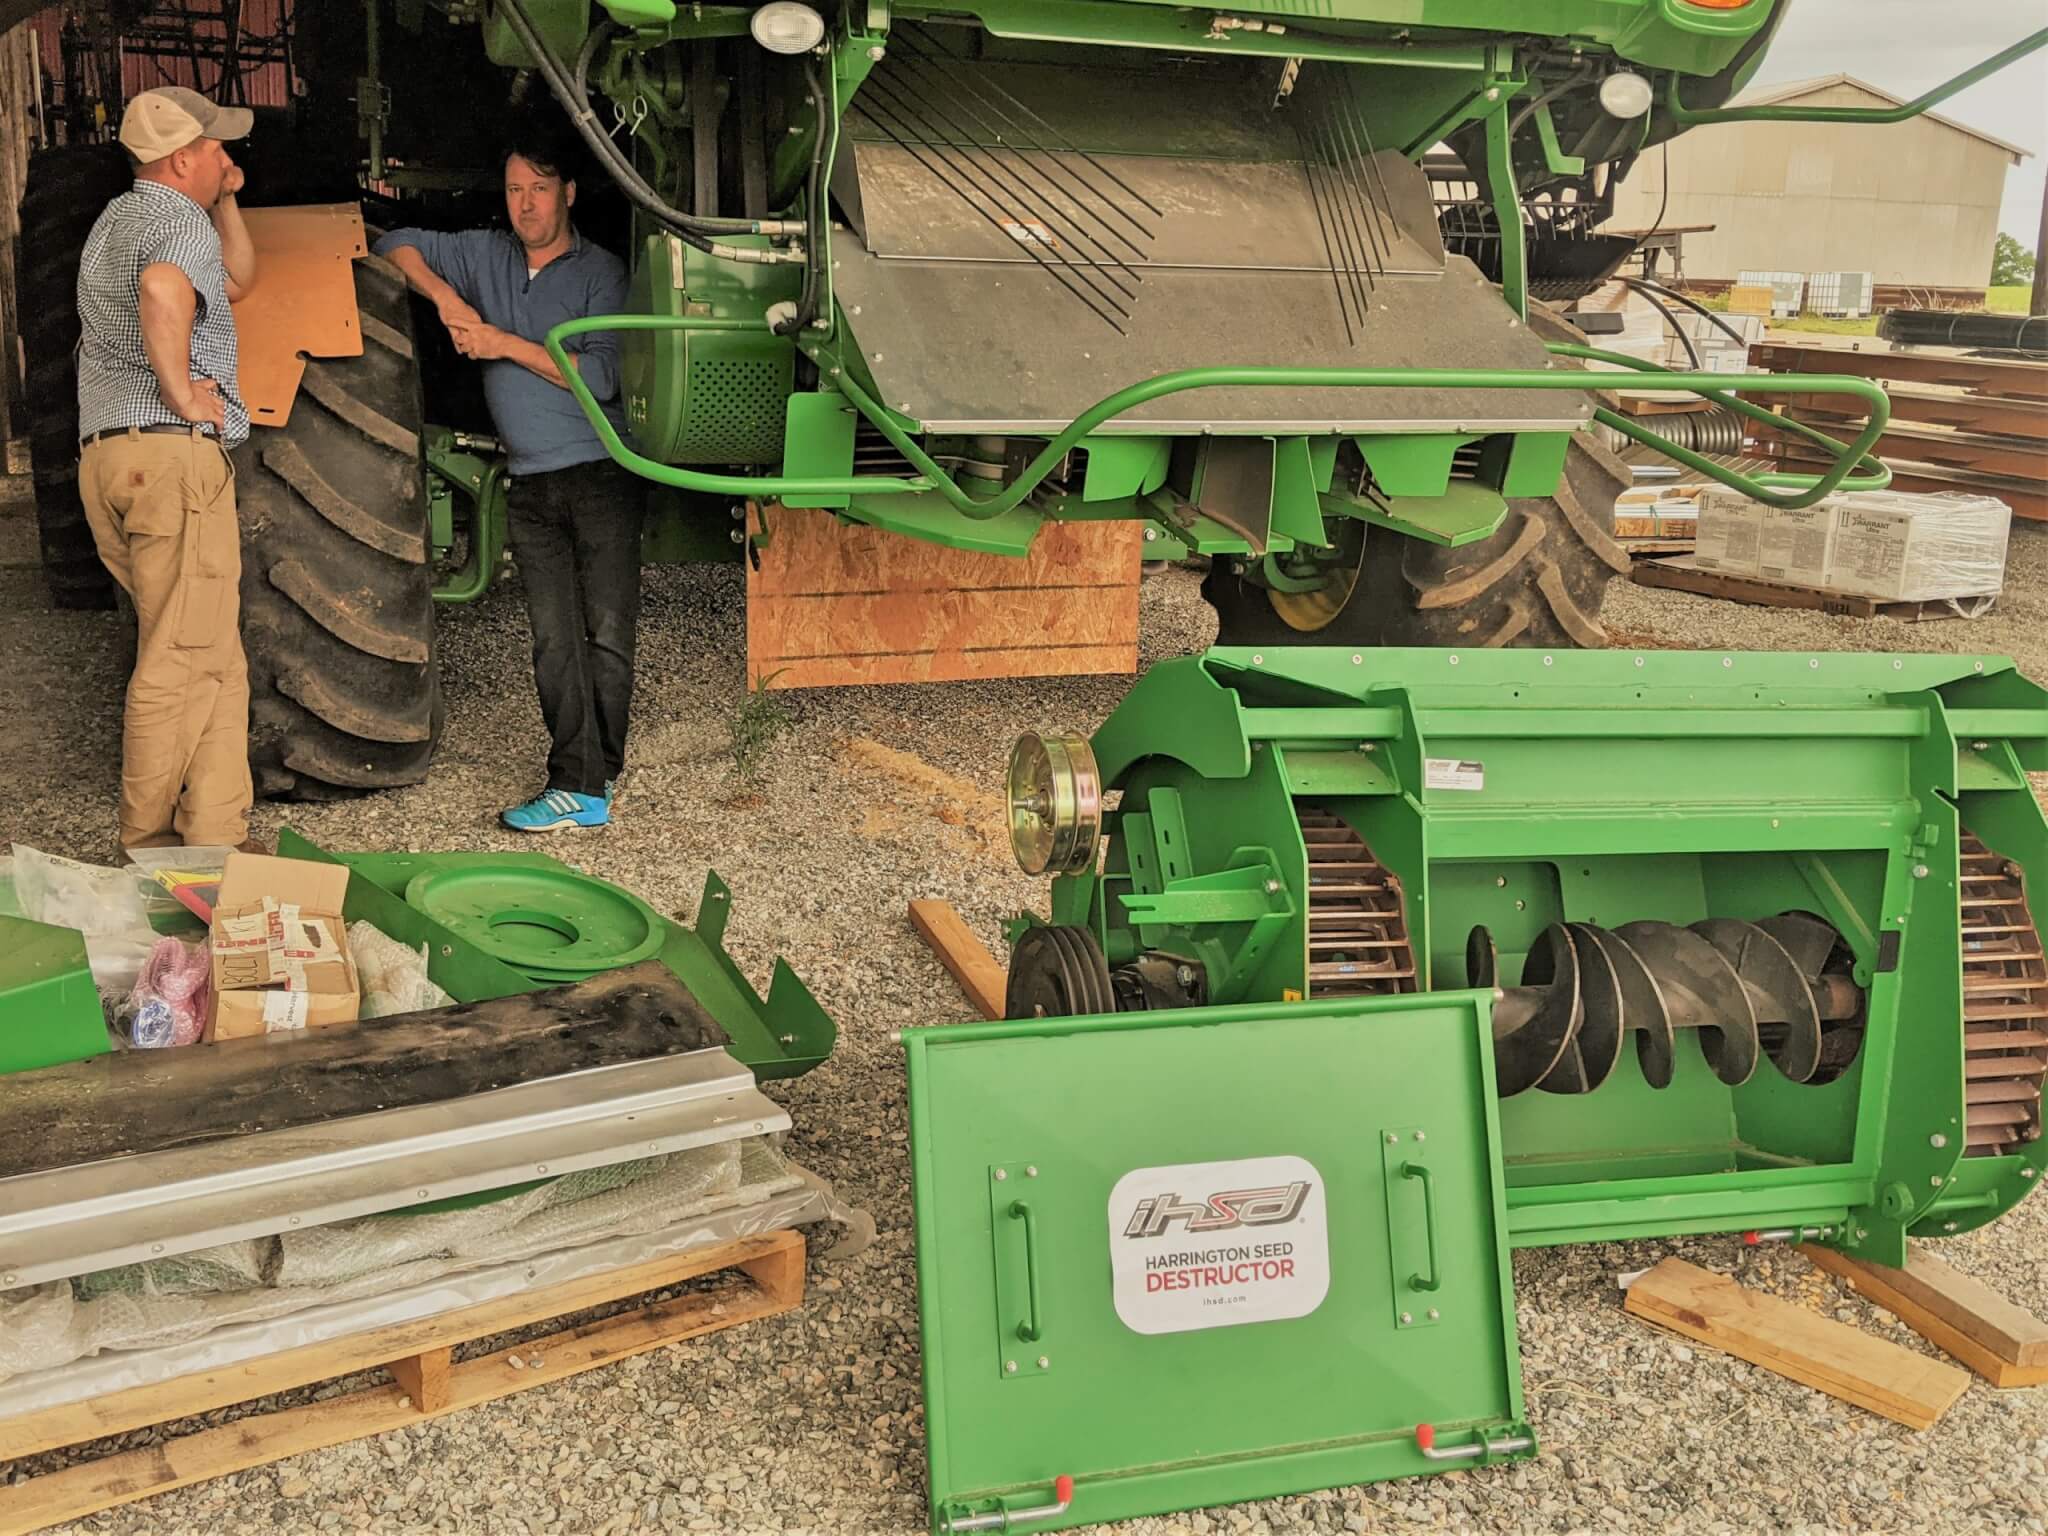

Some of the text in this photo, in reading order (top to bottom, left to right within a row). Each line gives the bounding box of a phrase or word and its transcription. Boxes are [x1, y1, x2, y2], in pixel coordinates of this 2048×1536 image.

[222, 954, 258, 985] BOLT
[1123, 1180, 1312, 1239] ihsd
[1145, 1241, 1294, 1271] HARRINGTON SEED
[1146, 1258, 1295, 1293] DESTRUCTOR
[1202, 1294, 1247, 1307] ihsd.com
